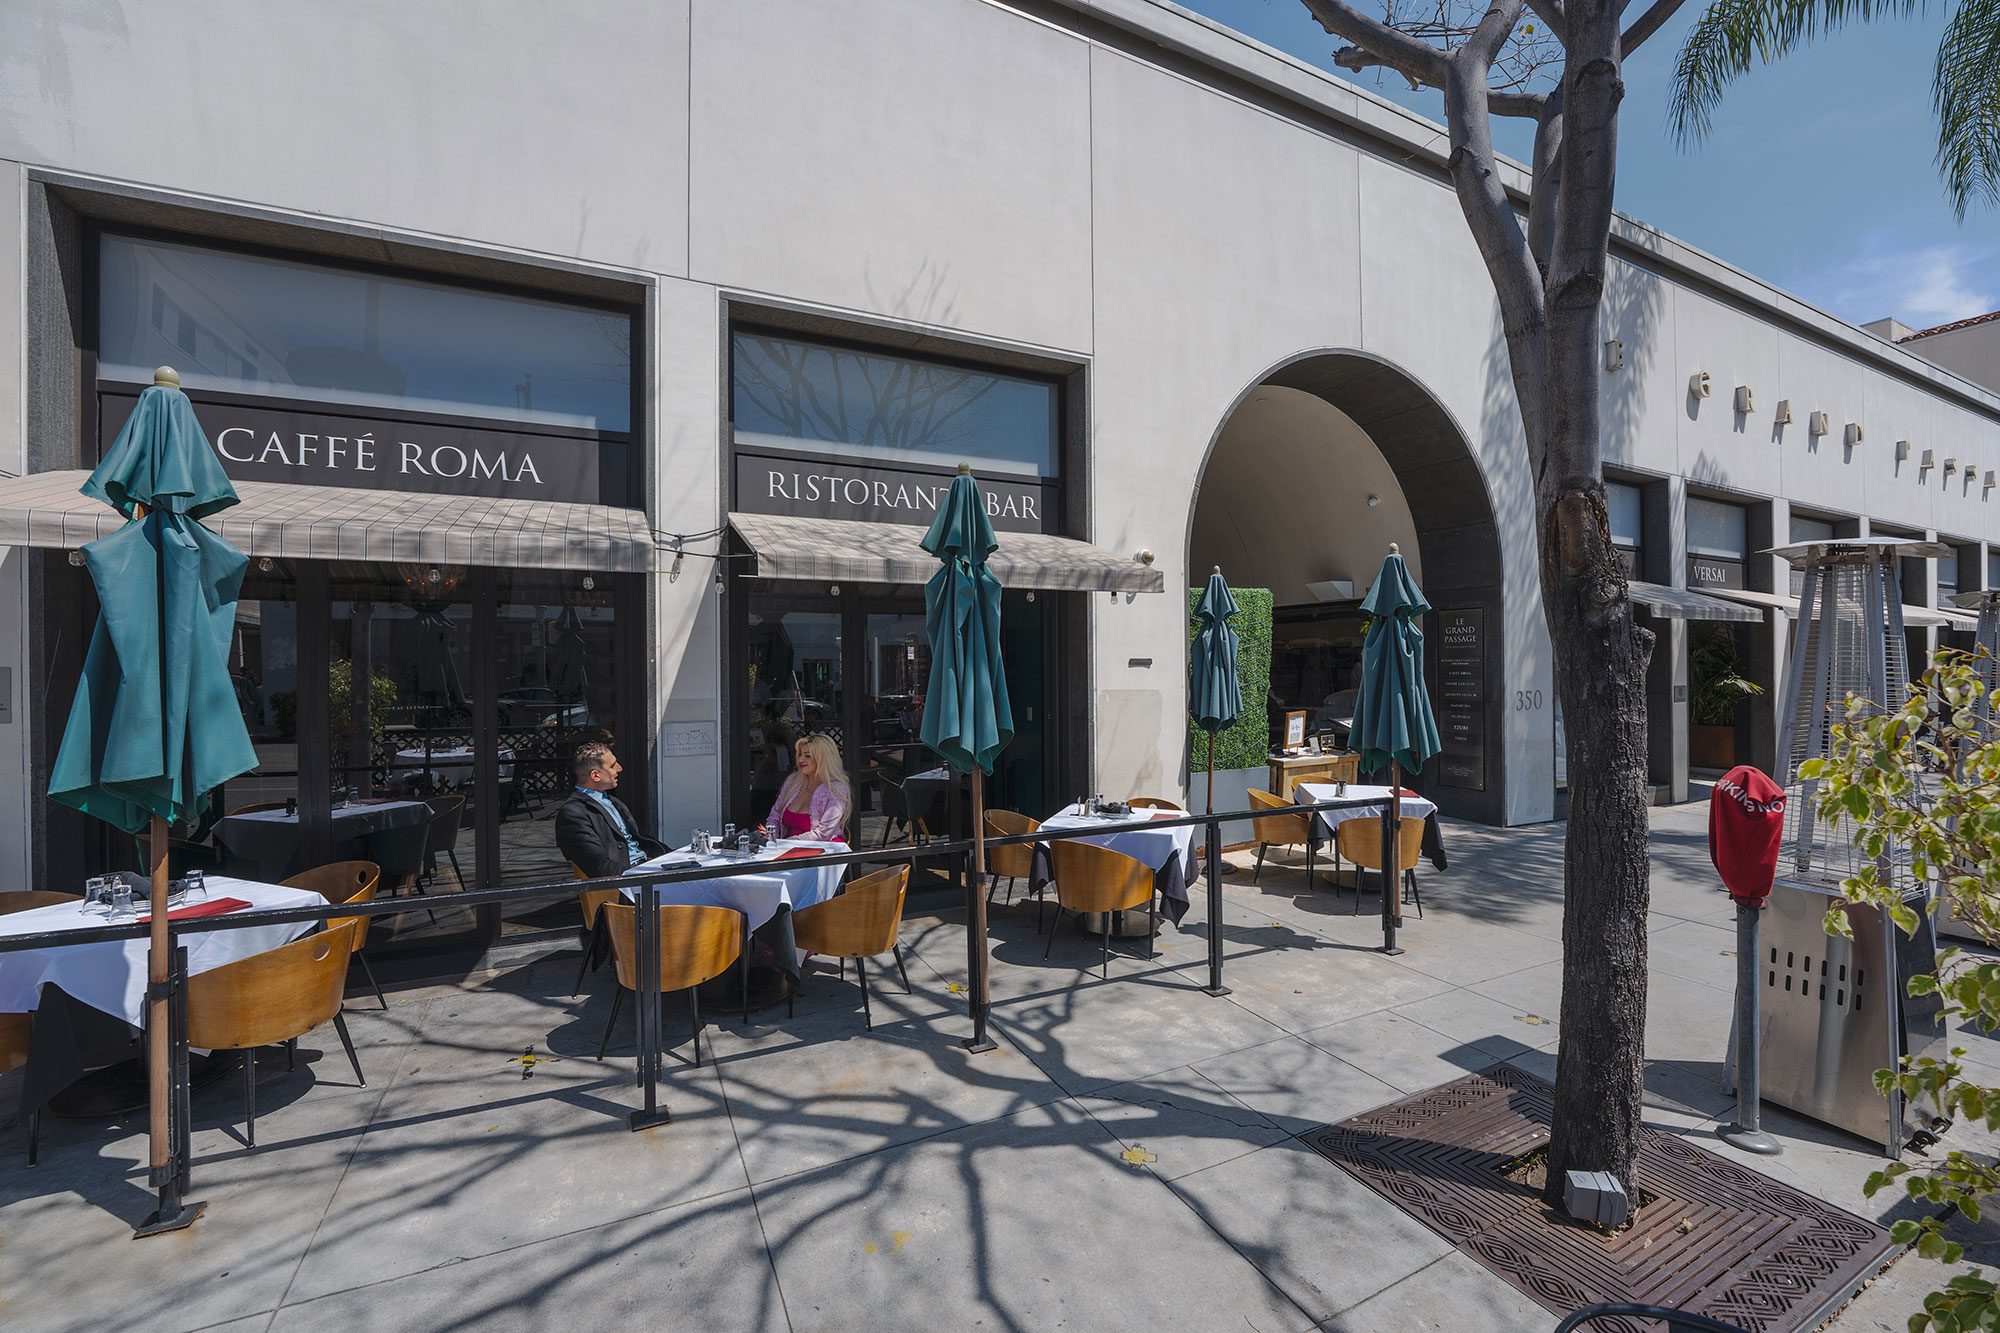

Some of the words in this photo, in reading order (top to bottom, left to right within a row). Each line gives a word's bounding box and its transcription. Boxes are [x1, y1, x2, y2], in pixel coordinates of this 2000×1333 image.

[216, 427, 377, 471] CAFFÉ
[398, 441, 544, 484] ROMA
[985, 491, 1040, 520] BAR
[1693, 565, 1726, 582] VERSAI
[1455, 617, 1465, 625] LE
[1444, 635, 1477, 643] PASSAGE
[1445, 626, 1476, 635] GRAND
[1516, 689, 1543, 711] 350
